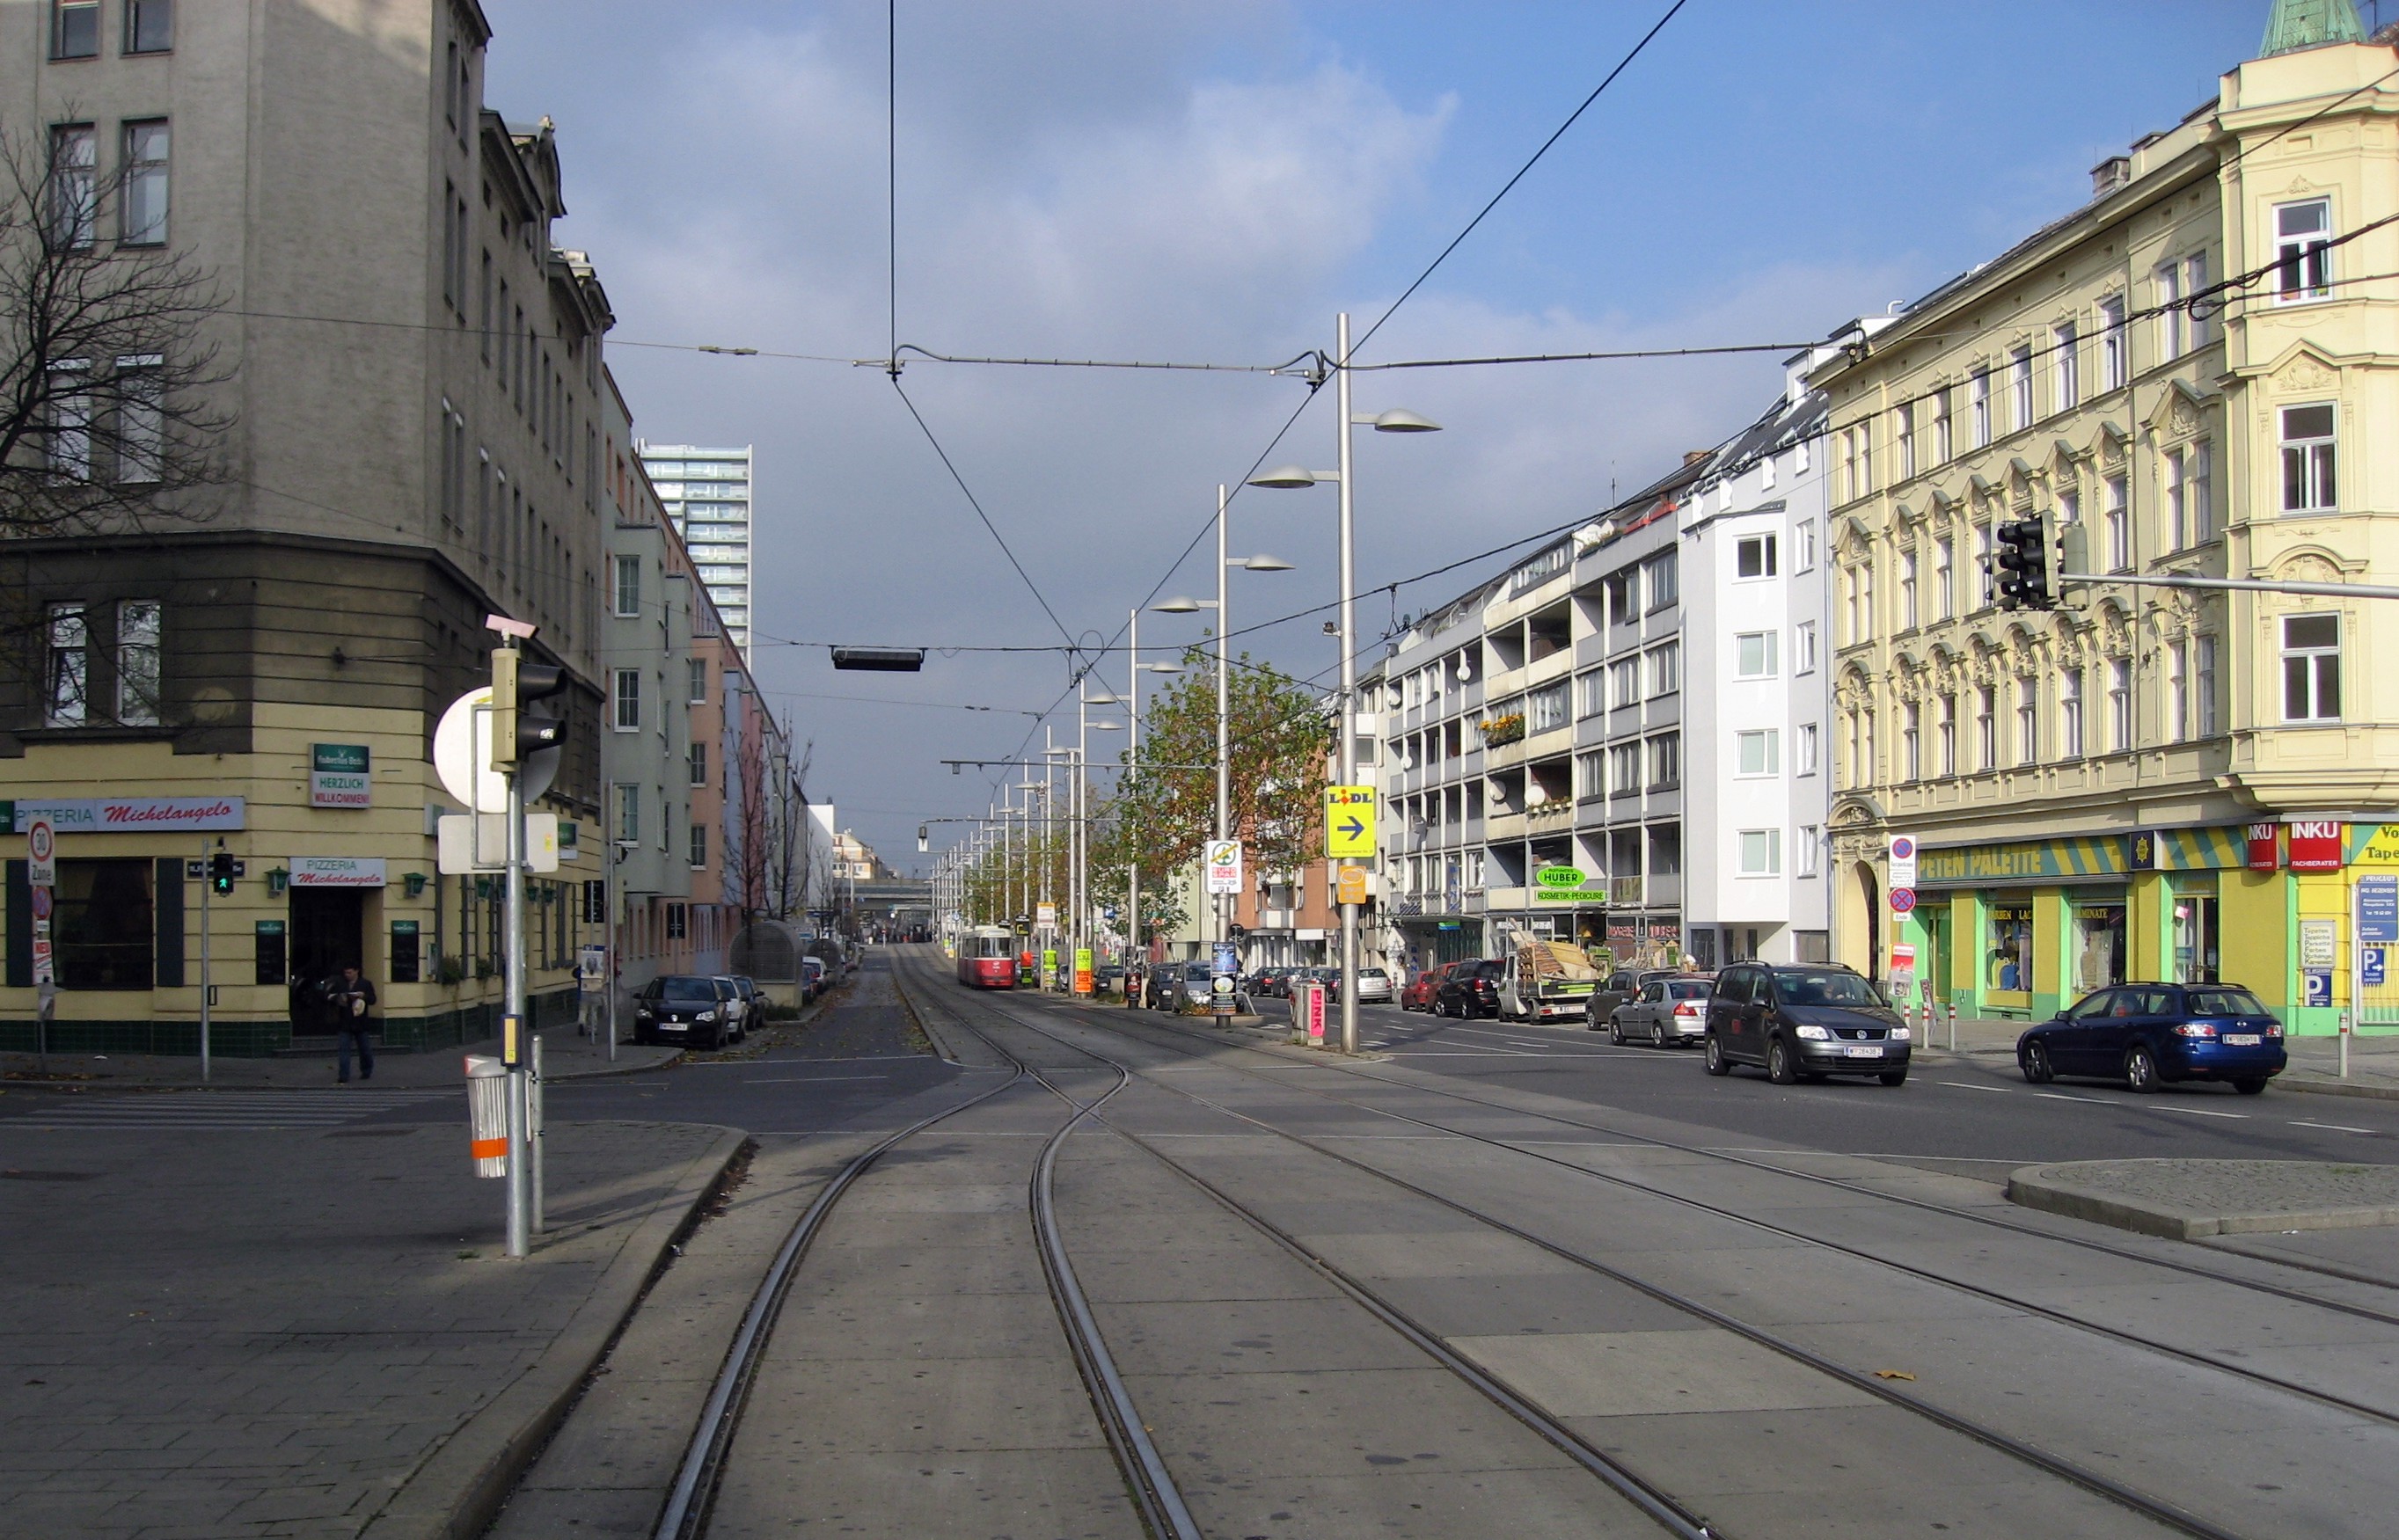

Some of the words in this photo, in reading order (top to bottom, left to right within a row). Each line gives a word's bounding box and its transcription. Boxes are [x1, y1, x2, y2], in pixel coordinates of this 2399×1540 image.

[319, 777, 363, 789] HERZLICH
[104, 802, 231, 823] Michelangelo
[2248, 823, 2272, 841] NKU
[2292, 821, 2337, 839] INKU
[36, 832, 46, 851] 30
[307, 859, 357, 871] PIZZERIA
[1918, 848, 1965, 879] PETEN
[1970, 843, 2042, 877] PALETTE
[32, 865, 51, 880] Zone
[297, 872, 381, 886] Michelangelo
[1544, 873, 1578, 882] HUBER
[2364, 950, 2377, 971] P
[2304, 975, 2322, 1007] P
